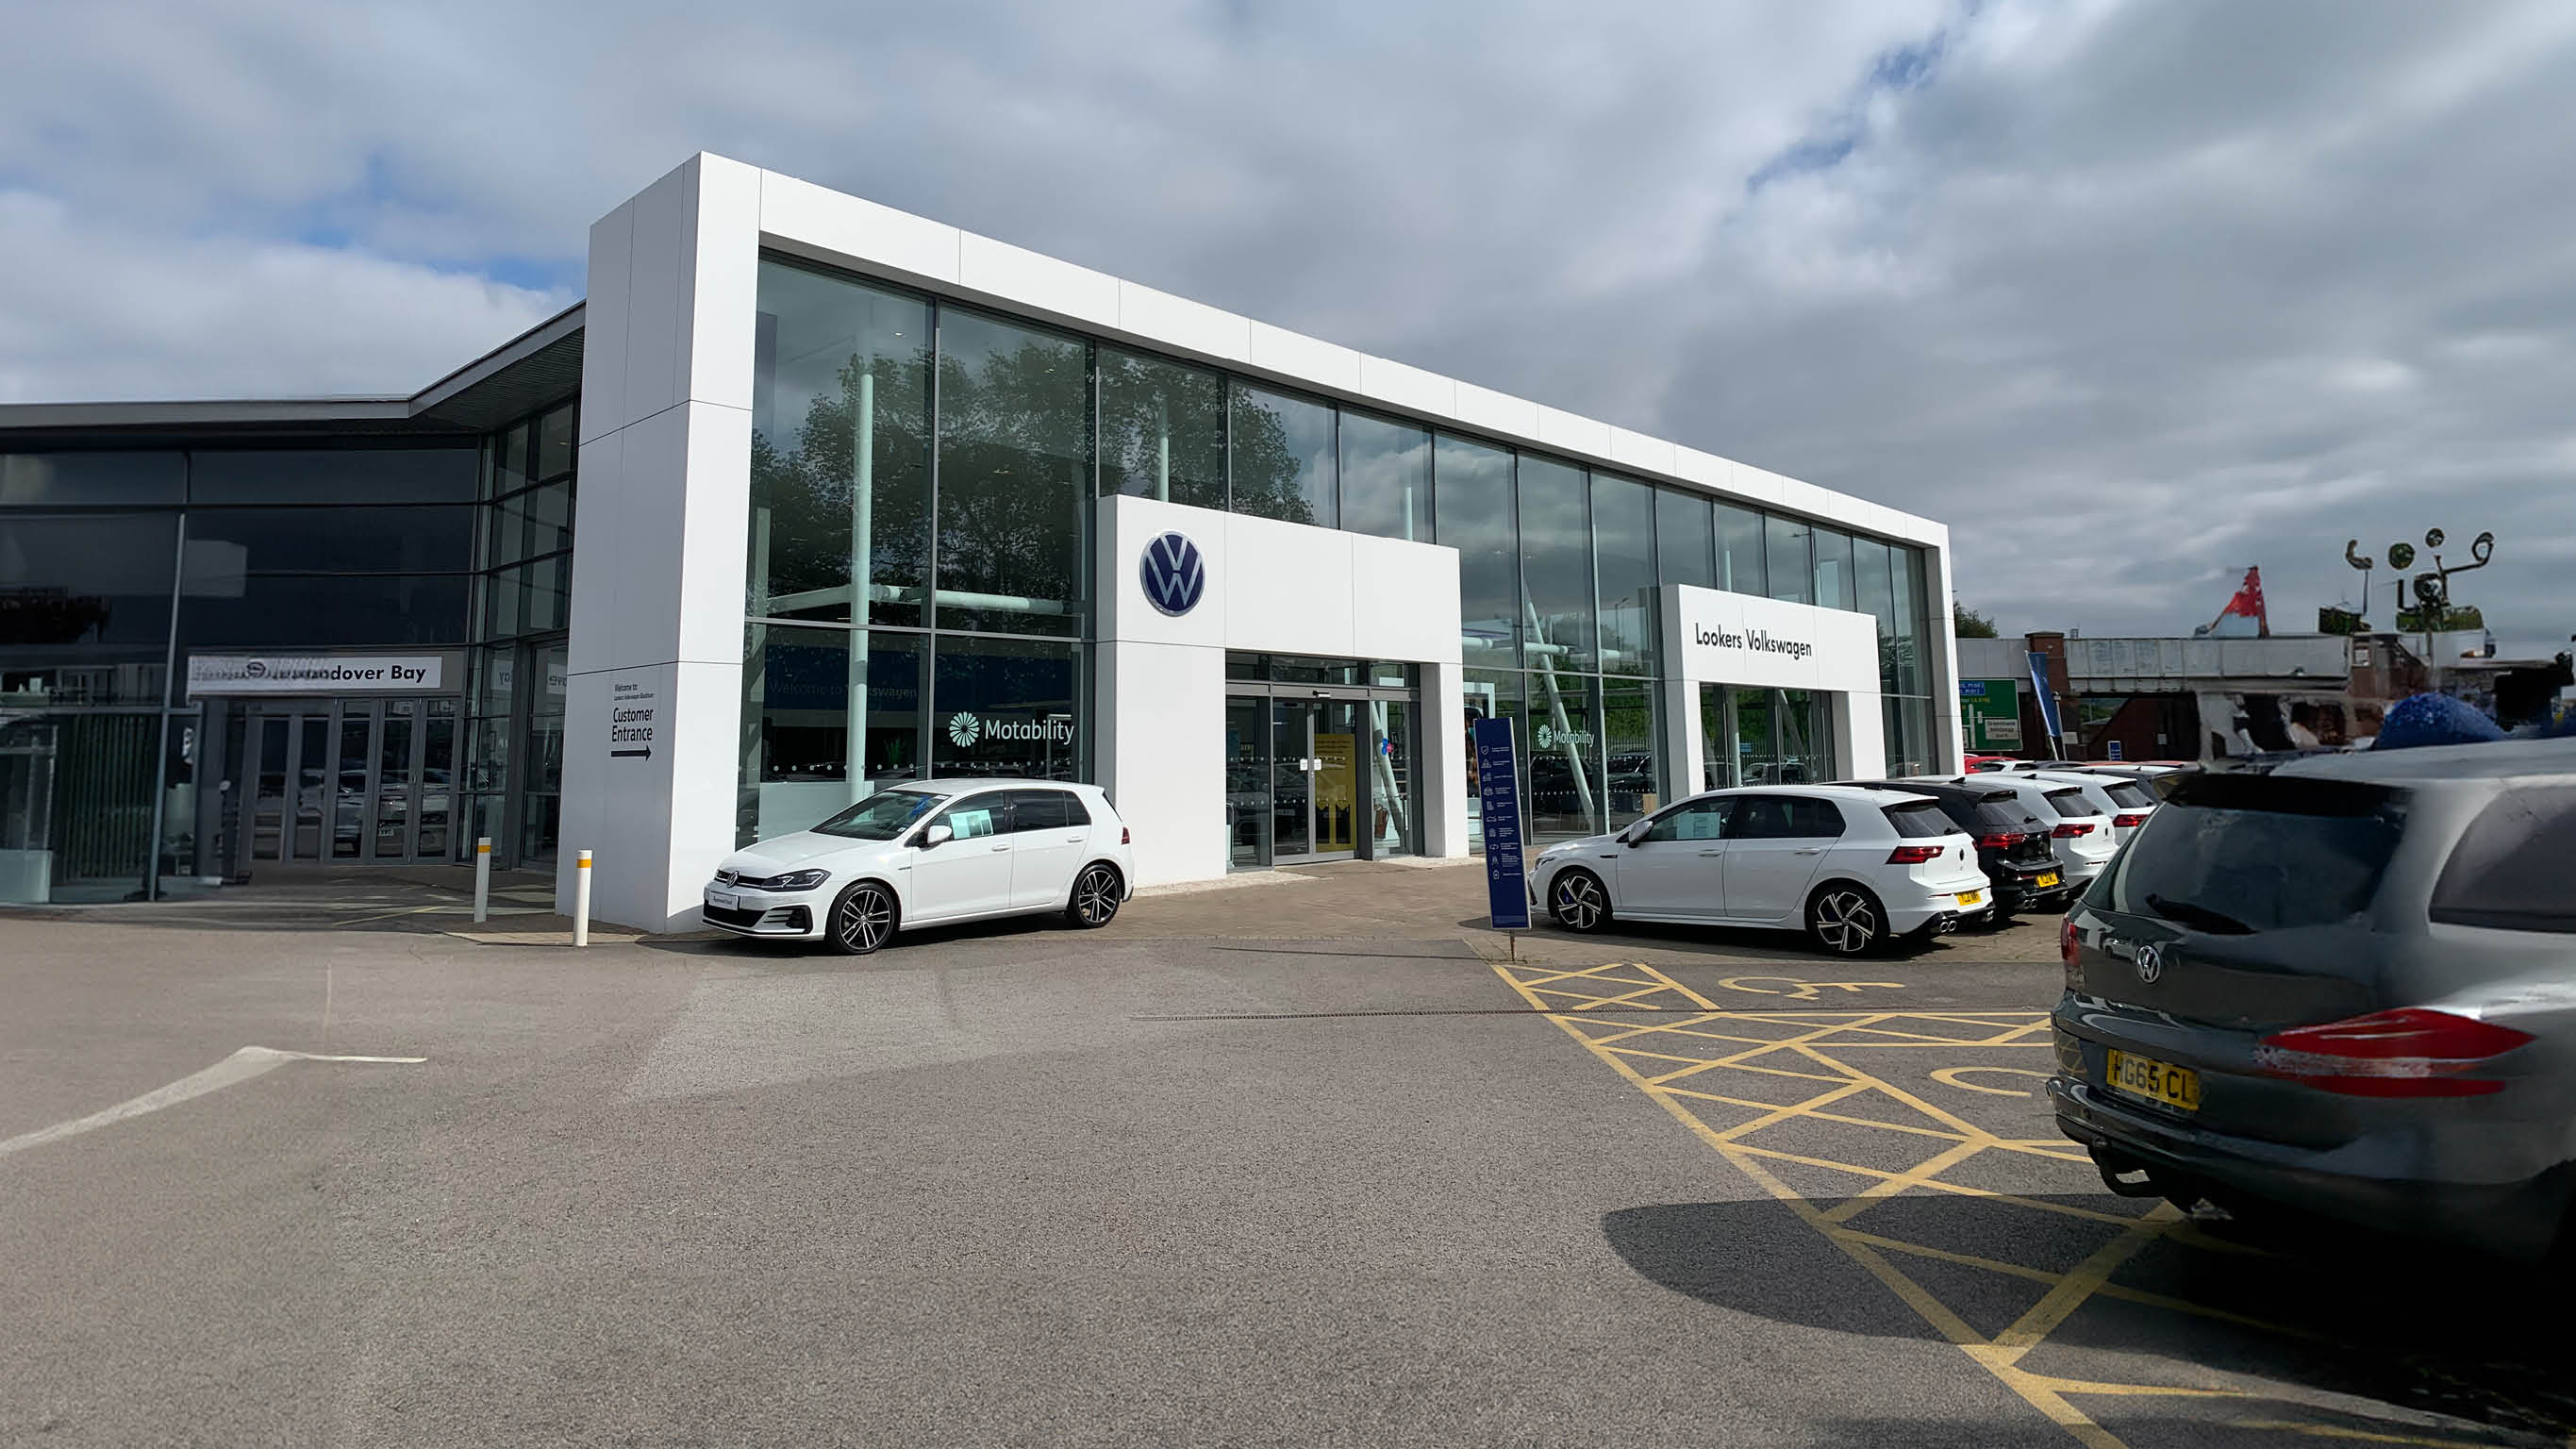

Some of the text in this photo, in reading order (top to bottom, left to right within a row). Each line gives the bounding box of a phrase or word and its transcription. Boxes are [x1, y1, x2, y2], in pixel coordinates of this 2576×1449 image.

[1695, 622, 1812, 660] Lookers Volkswagen
[391, 664, 426, 684] Bay
[613, 707, 654, 724] Customer
[611, 724, 653, 742] Entrance
[985, 719, 1074, 745] Motability
[1554, 729, 1595, 748] Motability
